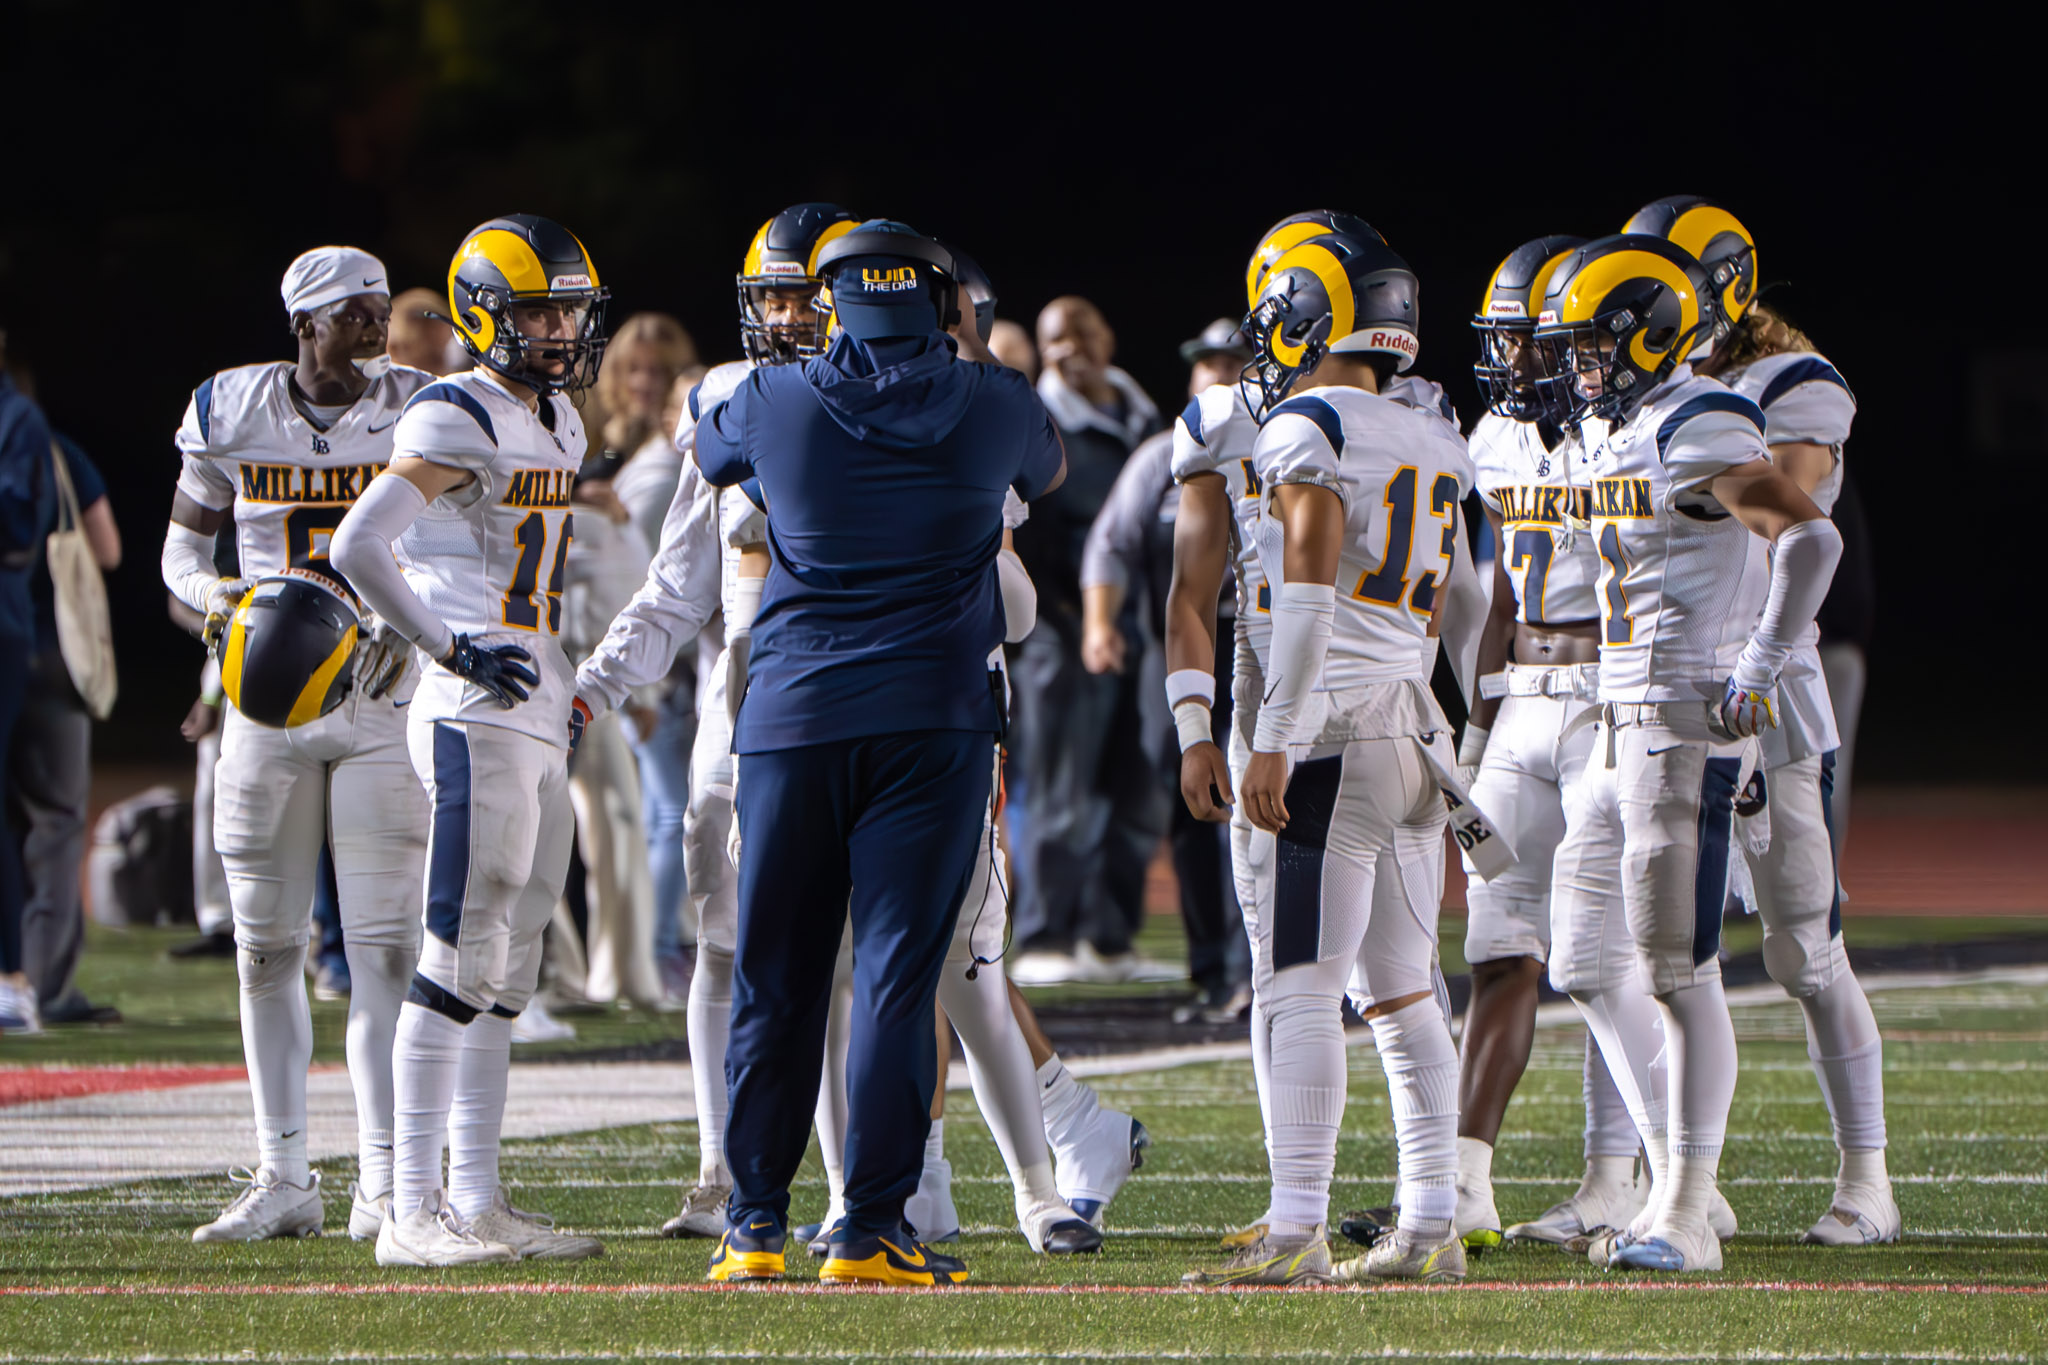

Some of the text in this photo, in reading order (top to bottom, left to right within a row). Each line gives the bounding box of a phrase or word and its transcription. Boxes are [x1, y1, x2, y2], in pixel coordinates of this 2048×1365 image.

[558, 276, 589, 288] Riddell
[862, 266, 916, 283] WIN
[862, 278, 917, 292] THE DAY
[240, 463, 390, 504] MILLIKA
[1353, 465, 1460, 616] 13
[1511, 526, 1555, 624] 7
[1600, 521, 1634, 646] 1
